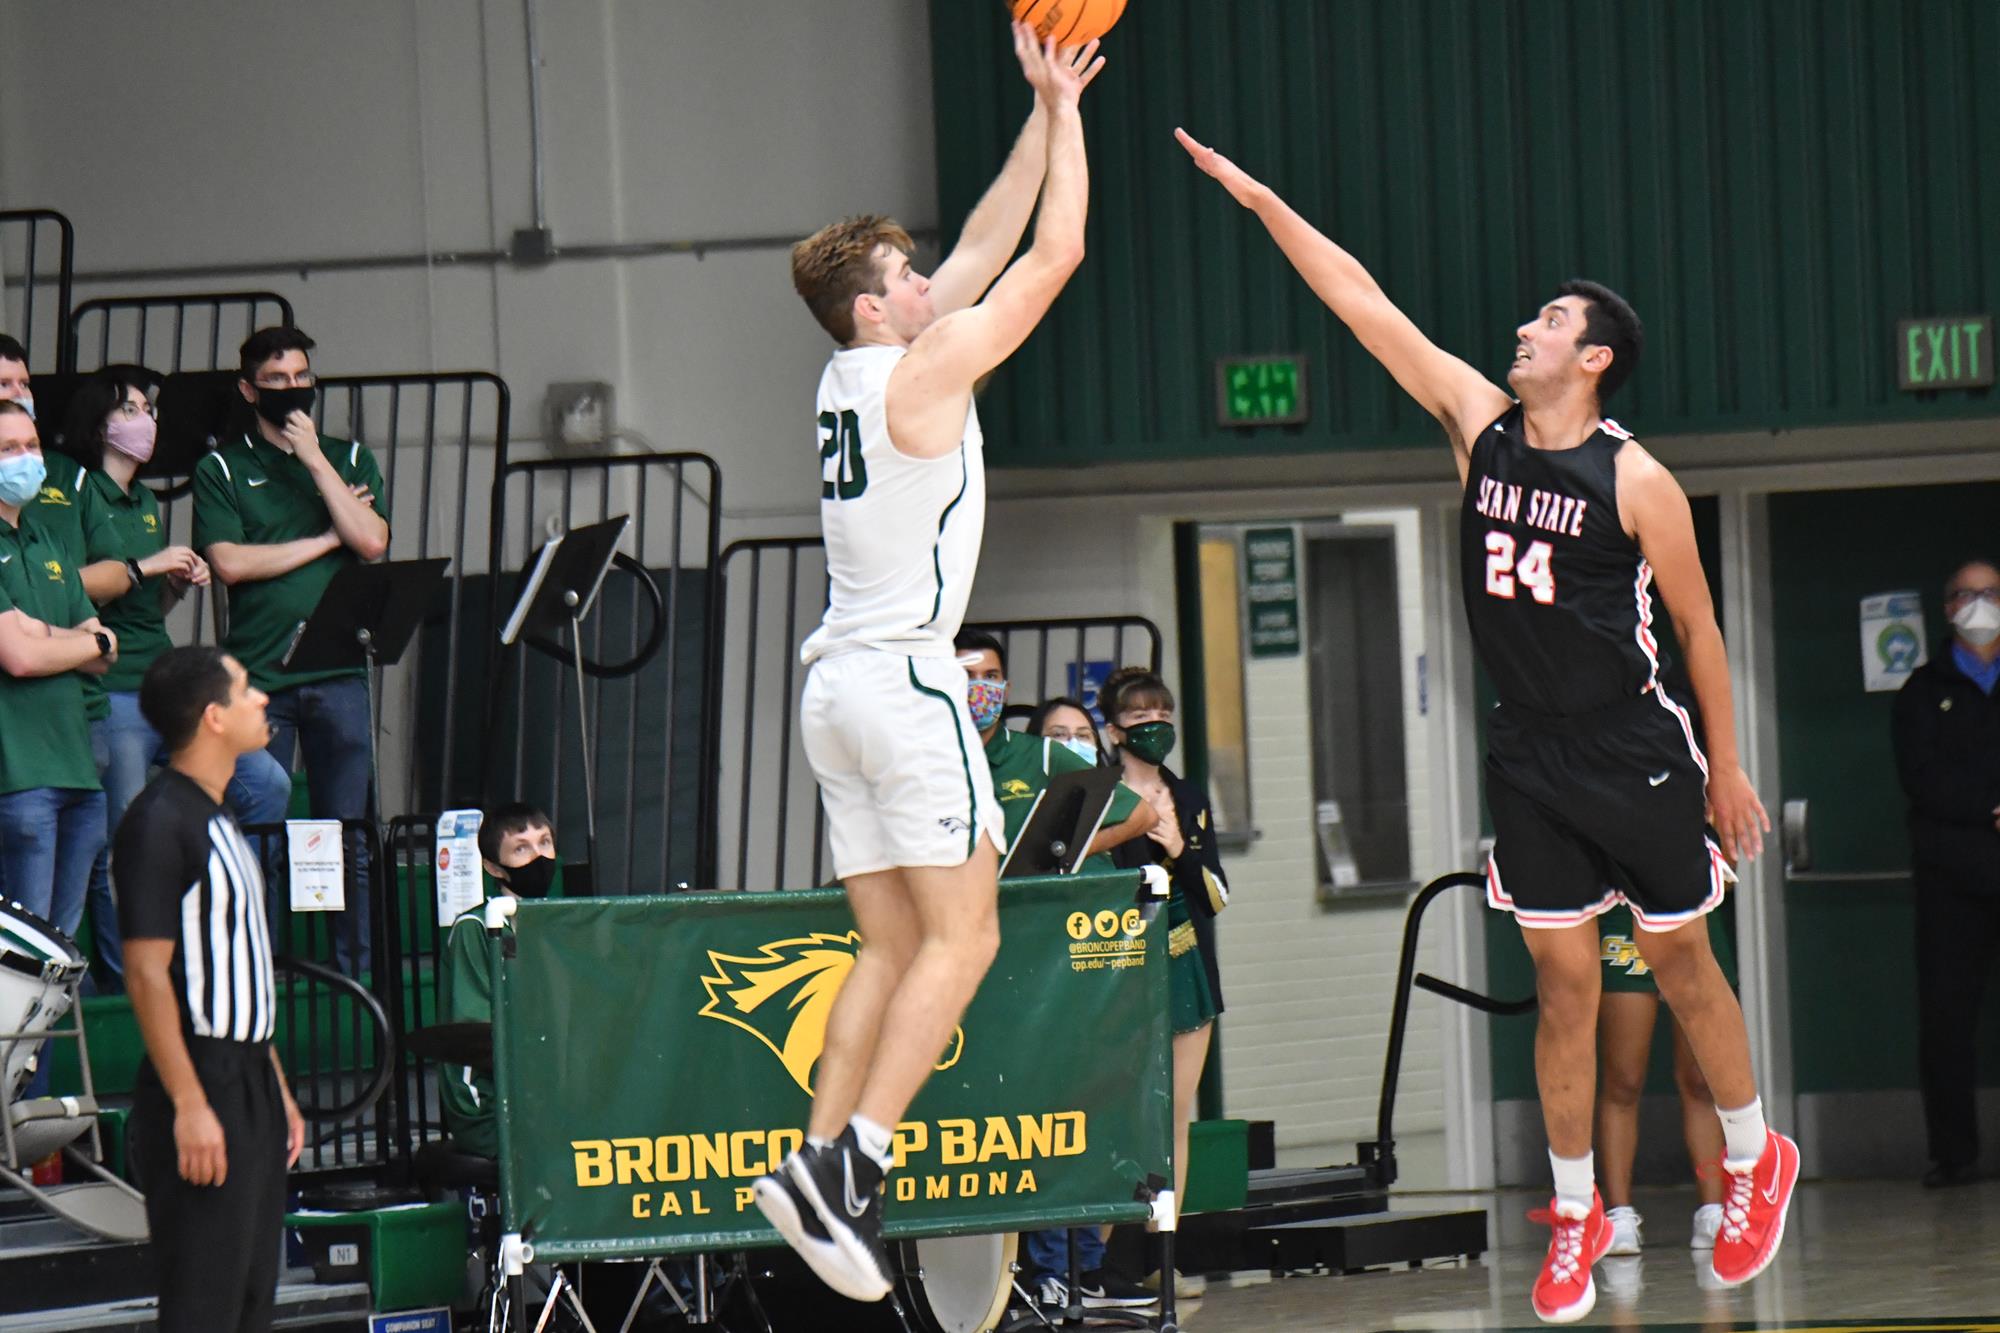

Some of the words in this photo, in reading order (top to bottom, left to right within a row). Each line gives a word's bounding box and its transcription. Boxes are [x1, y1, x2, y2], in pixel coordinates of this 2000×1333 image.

[1907, 324, 1983, 383] EXIT
[818, 409, 868, 500] 20
[1526, 488, 1587, 537] STATE
[1485, 530, 1556, 606] 24
[1068, 940, 1146, 954] @BRONCOPEPBAND
[570, 1128, 804, 1187] BRONCO
[936, 1111, 1087, 1165] BAND
[632, 1190, 711, 1218] CAL
[879, 1169, 1038, 1202] OMONA
